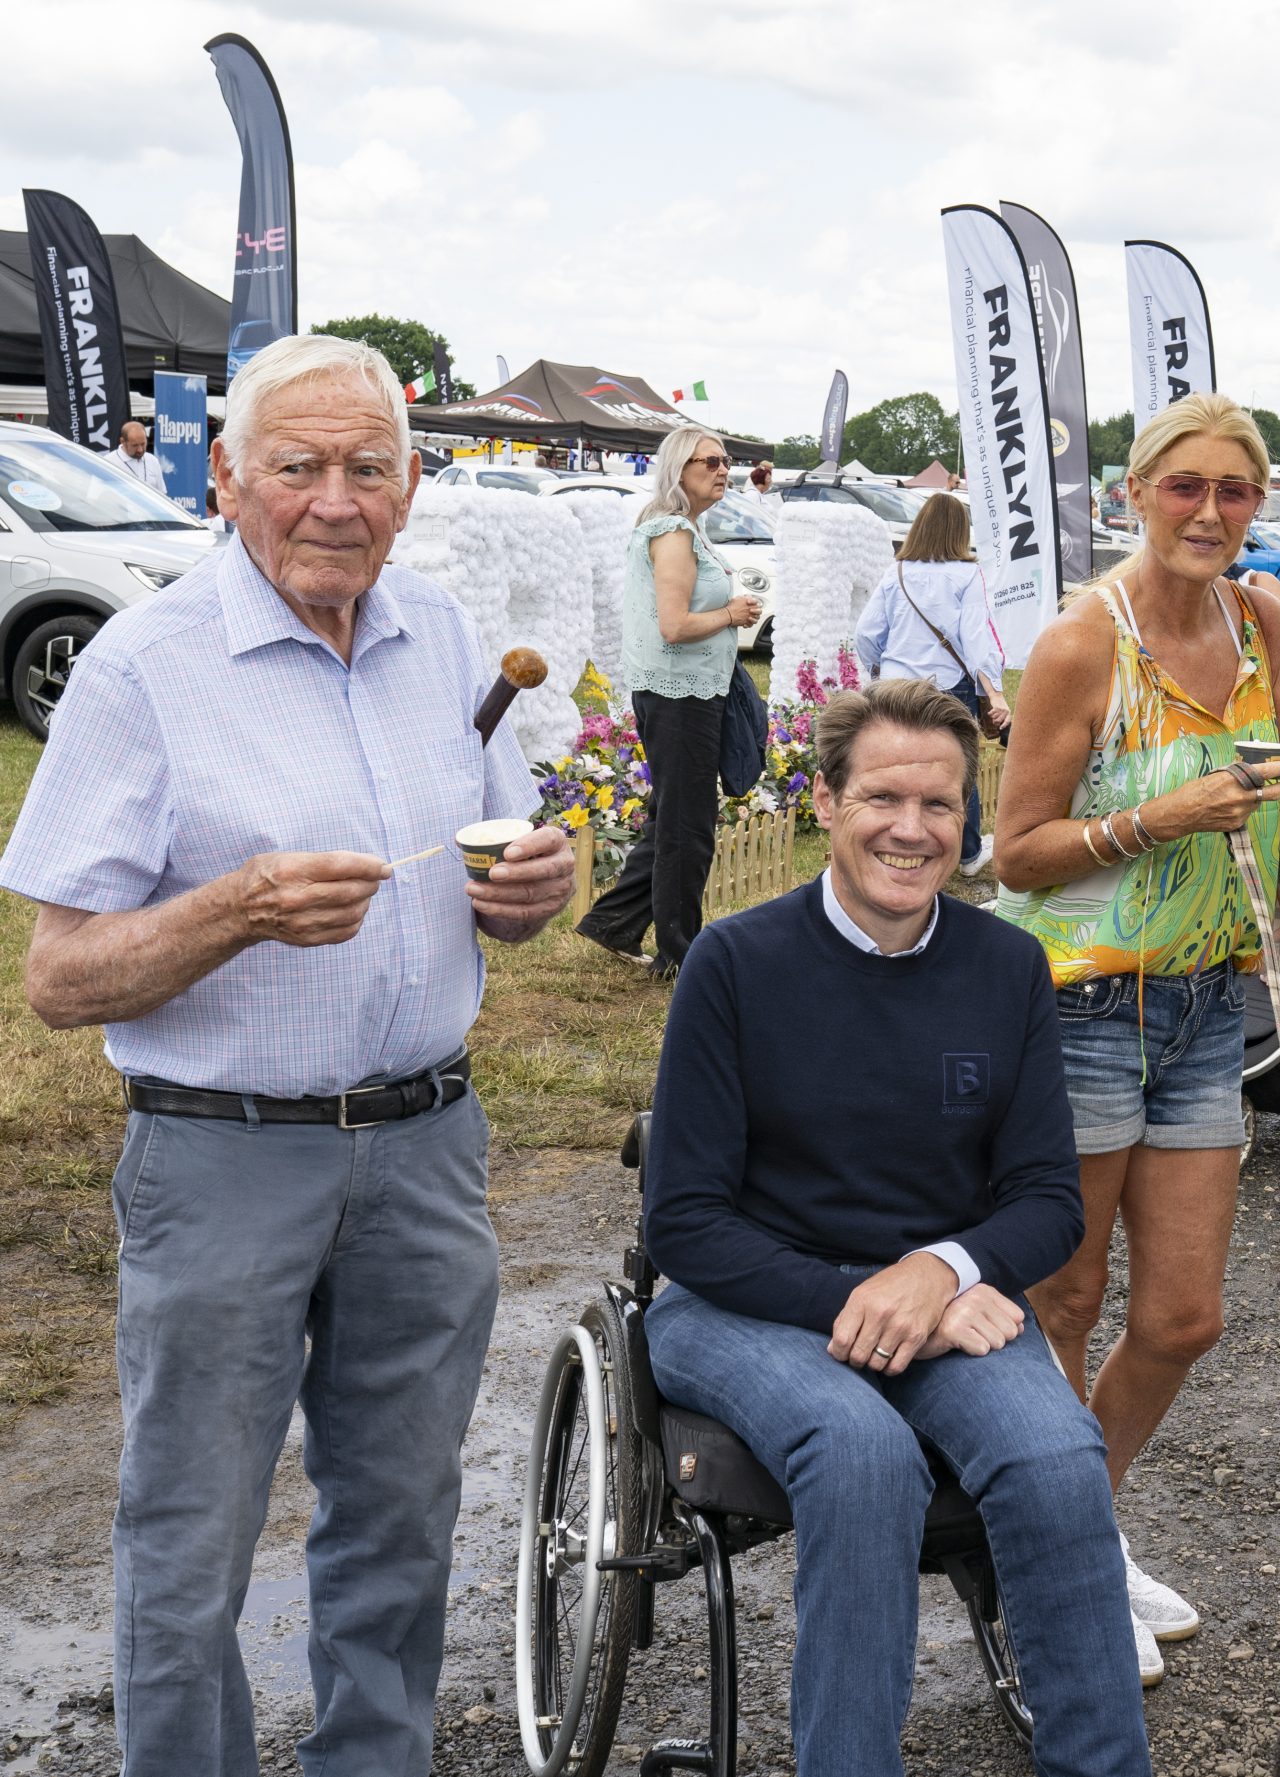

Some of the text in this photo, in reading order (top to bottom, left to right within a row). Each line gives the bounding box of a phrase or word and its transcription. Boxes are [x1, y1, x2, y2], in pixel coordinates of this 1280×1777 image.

[47, 246, 81, 444] Financial planning that's as unique
[67, 266, 110, 454] FRANKLY
[966, 333, 982, 398] planning
[1143, 295, 1158, 411] Financial planning
[1162, 316, 1191, 405] FRA
[157, 414, 201, 445] Happy
[974, 401, 986, 442] that's
[983, 284, 1040, 561] FRANKLYN
[979, 446, 988, 462] as
[981, 465, 997, 519] unique
[991, 522, 1001, 538] as
[994, 591, 1036, 608] franklyn.co.uk
[1009, 585, 1019, 594] 291
[1020, 581, 1034, 590] 825
